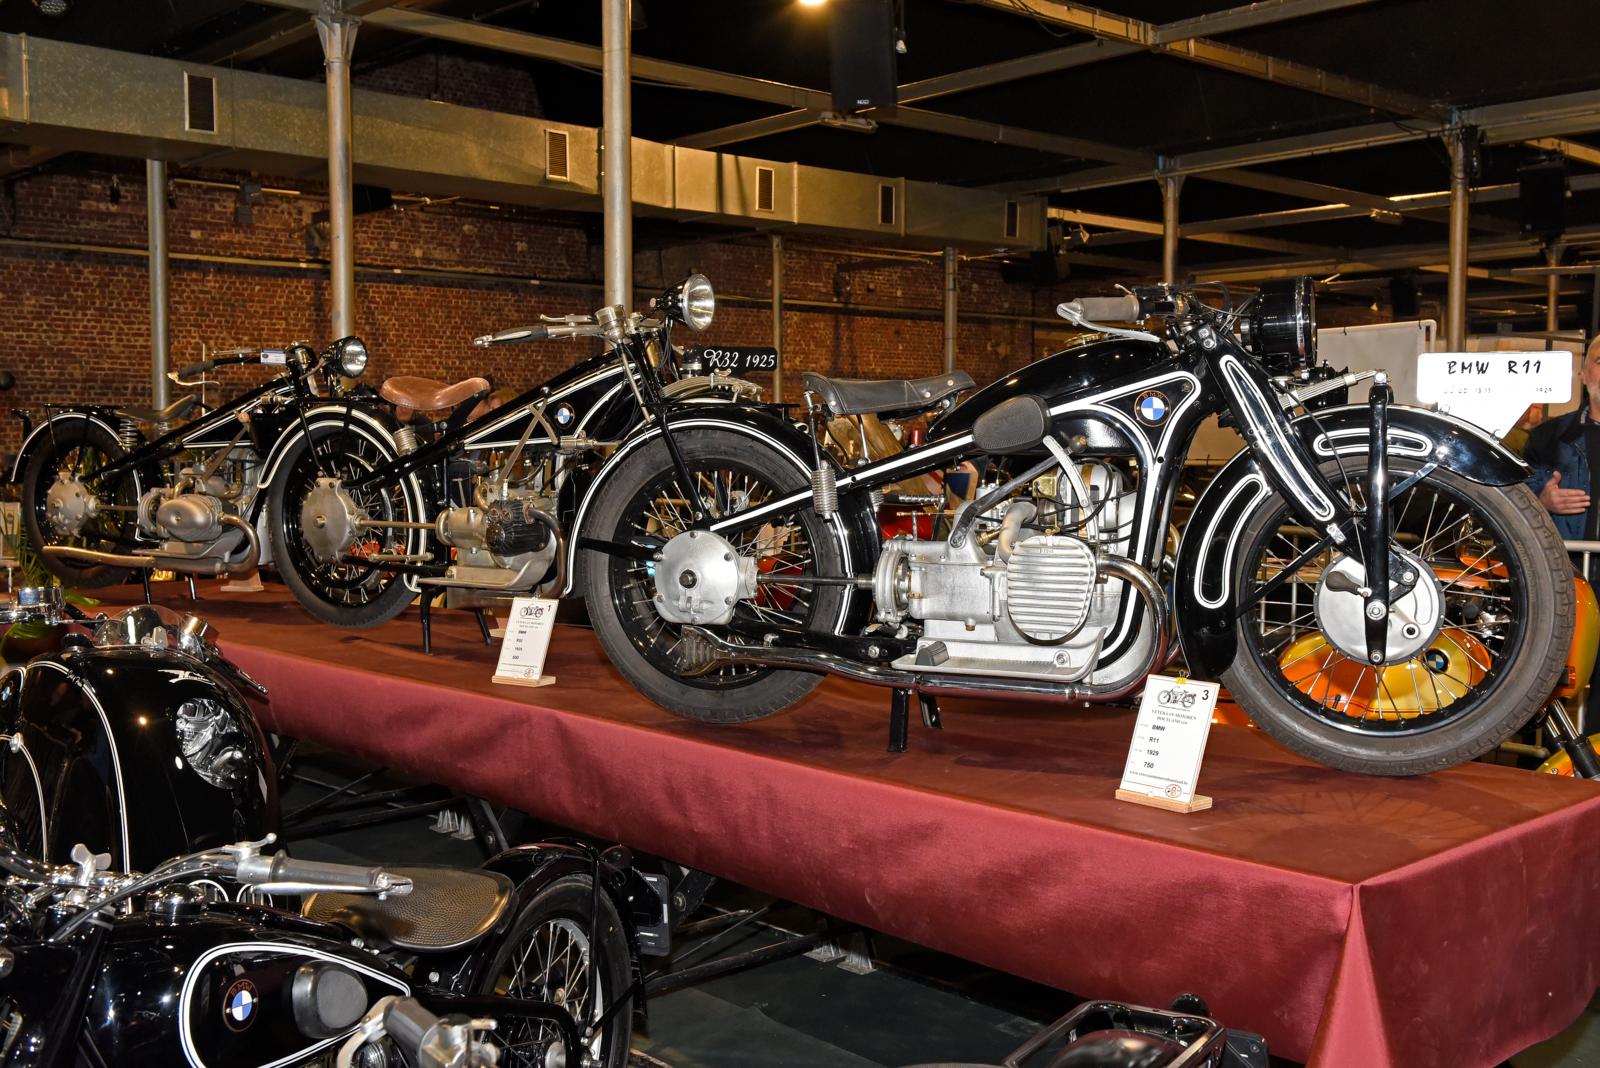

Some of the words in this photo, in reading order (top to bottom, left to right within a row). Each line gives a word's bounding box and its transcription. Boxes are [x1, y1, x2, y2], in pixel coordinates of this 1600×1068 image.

[703, 348, 739, 368] R32
[745, 354, 776, 368] 1925
[1447, 360, 1490, 375] BMW
[1508, 360, 1541, 374] R11
[1142, 391, 1164, 399] BMW
[1202, 690, 1209, 700] 3
[1151, 724, 1166, 732] BMW
[230, 981, 253, 996] BMW
